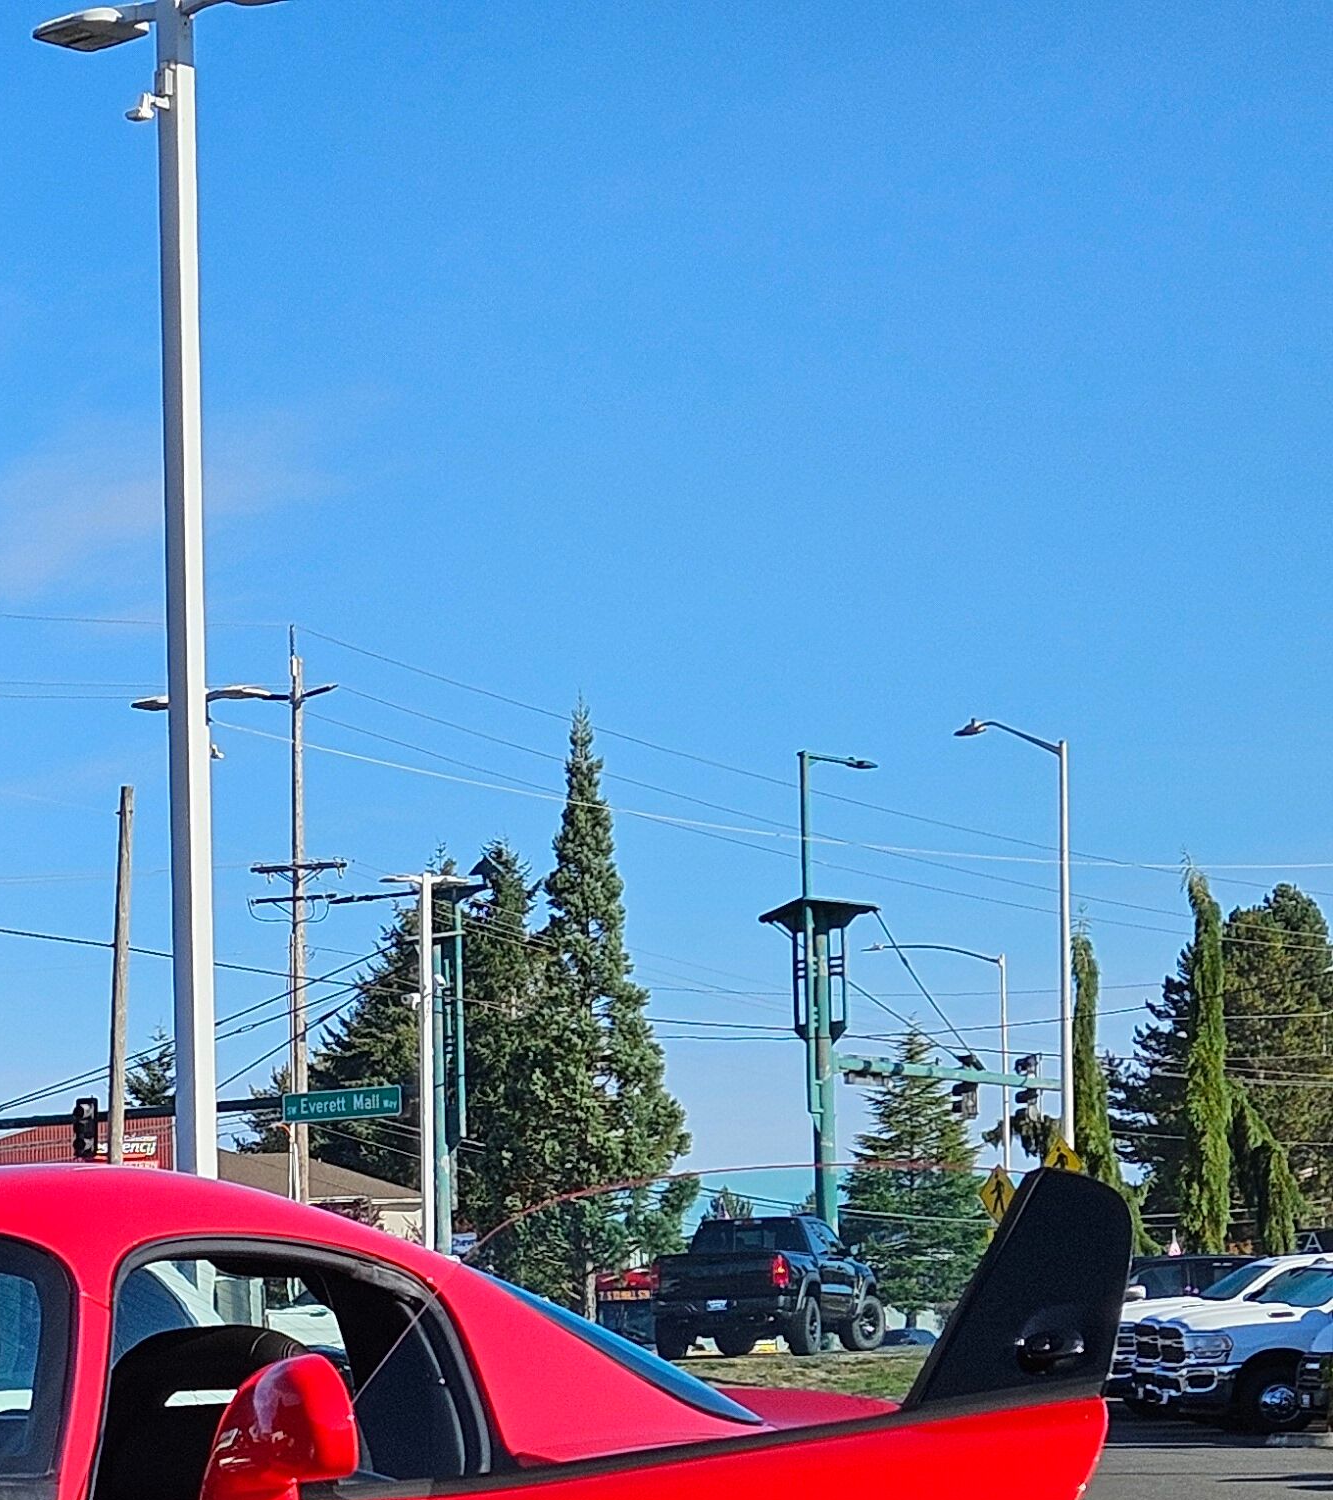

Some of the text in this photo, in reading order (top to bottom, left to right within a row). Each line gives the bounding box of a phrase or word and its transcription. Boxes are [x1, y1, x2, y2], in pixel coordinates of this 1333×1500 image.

[300, 1096, 346, 1114] Everett
[353, 1093, 380, 1110] Mall
[382, 1099, 397, 1109] Way
